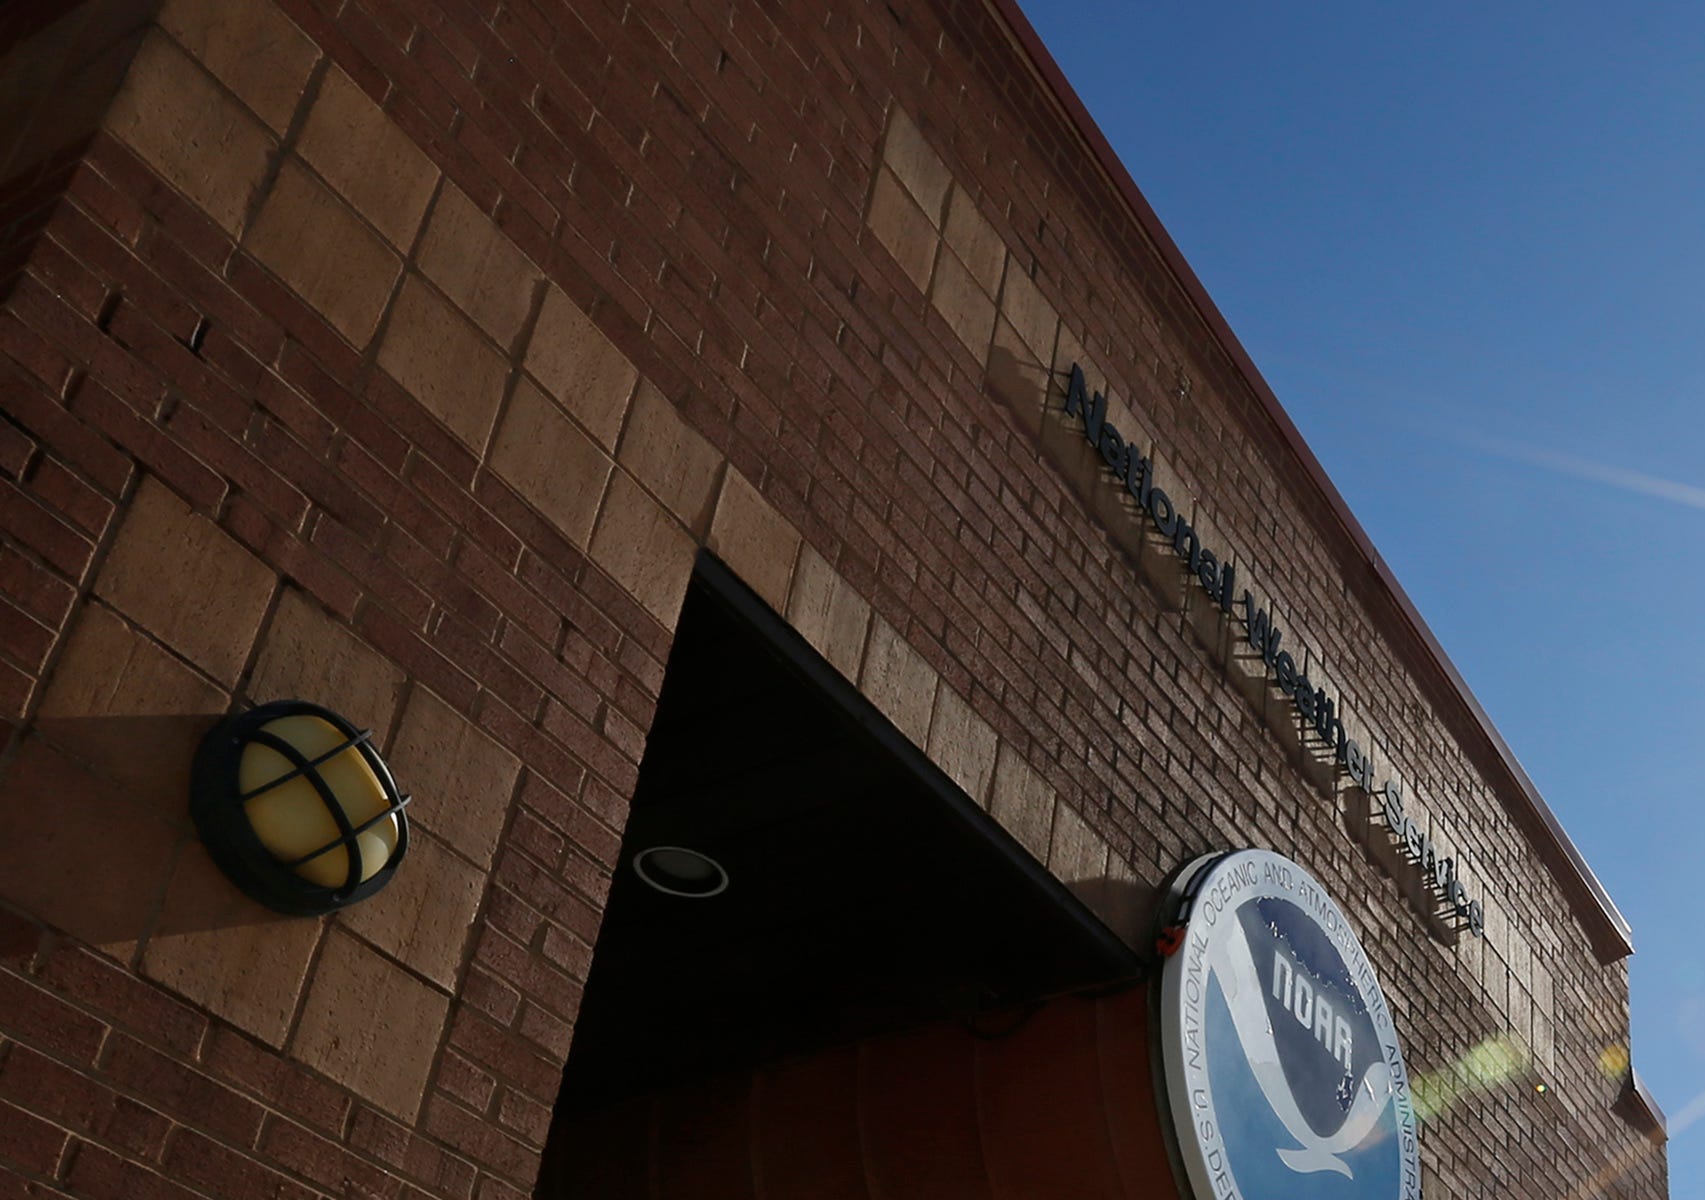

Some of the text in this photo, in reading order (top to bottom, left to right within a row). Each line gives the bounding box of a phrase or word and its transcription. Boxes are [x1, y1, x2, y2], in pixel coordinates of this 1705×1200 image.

[1066, 362, 1484, 937] National Weather Service
[1183, 935, 1209, 1070] NATIONAL
[1202, 861, 1258, 927] OCEANIC
[1264, 862, 1294, 891] AND
[1299, 881, 1388, 1030] ATMOSPHERIC
[1272, 950, 1353, 1073] NOAA
